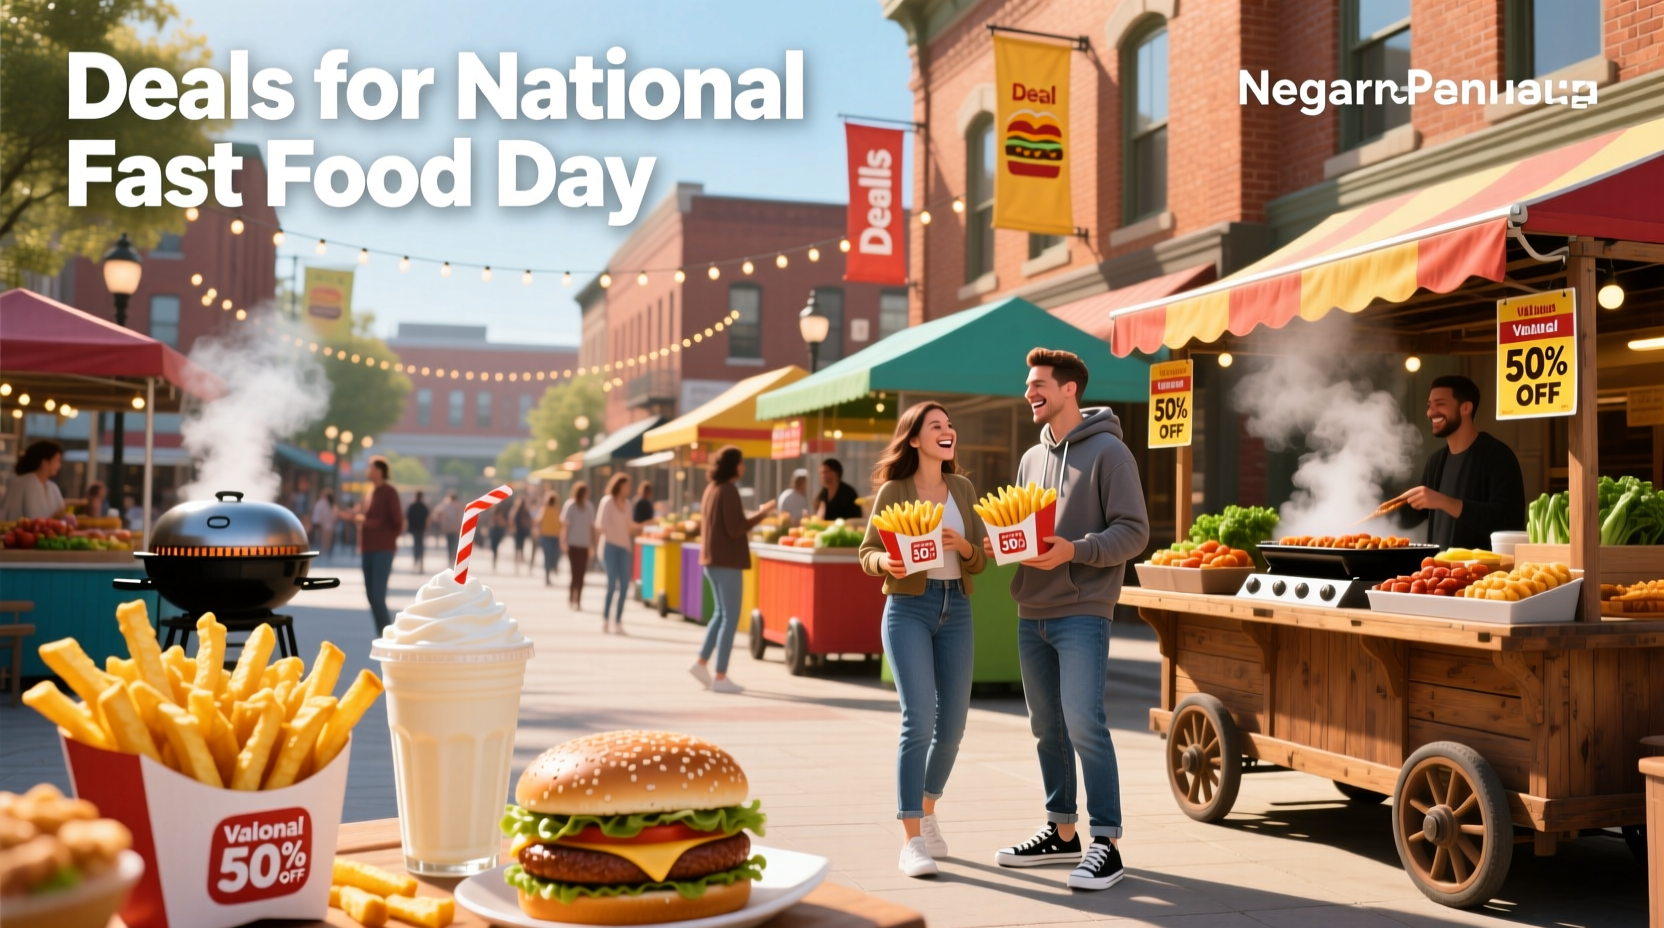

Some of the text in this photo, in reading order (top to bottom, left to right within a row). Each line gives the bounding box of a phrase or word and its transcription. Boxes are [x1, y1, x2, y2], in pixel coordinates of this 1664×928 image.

[1012, 83, 1057, 105] Deal
[858, 148, 893, 256] Dealls
[1505, 345, 1568, 382] 50%
[1516, 381, 1562, 407] OFF
[1154, 396, 1188, 422] 50%
[1159, 423, 1184, 439] OFF
[217, 839, 307, 893] 50%
[279, 868, 306, 885] OFF
